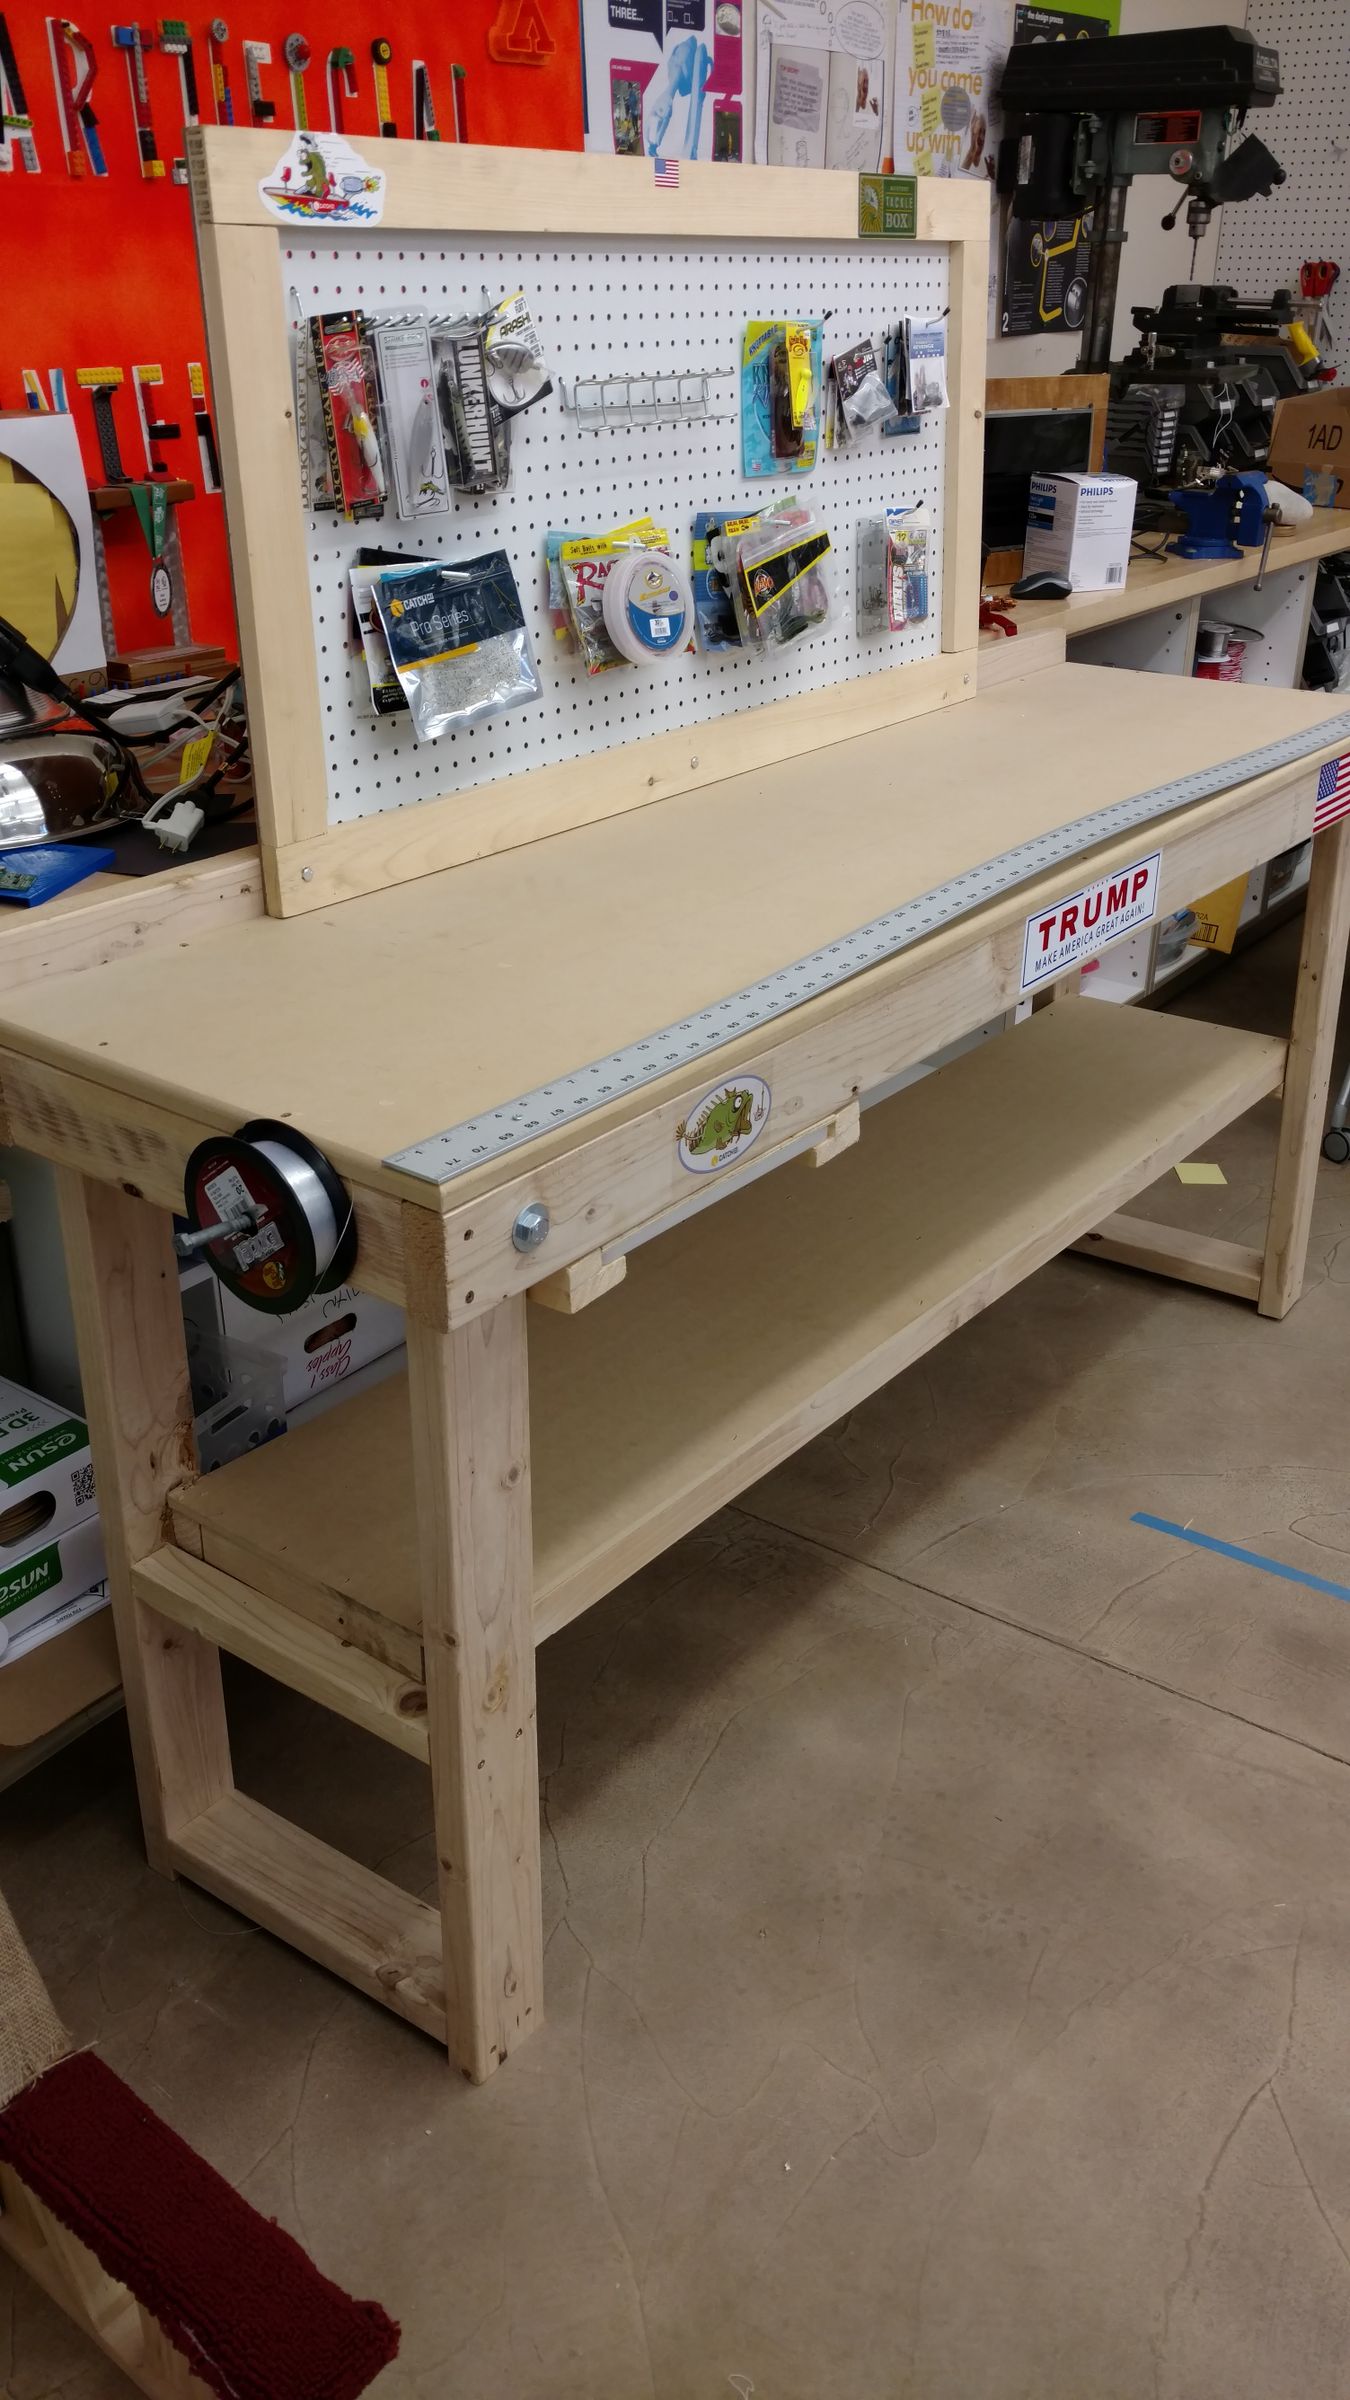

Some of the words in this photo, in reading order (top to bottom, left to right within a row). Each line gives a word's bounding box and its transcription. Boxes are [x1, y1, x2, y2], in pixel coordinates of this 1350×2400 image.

[952, 0, 973, 31] do
[907, 67, 938, 96] you
[940, 70, 983, 95] come
[905, 131, 926, 155] up
[885, 213, 908, 228] BOX
[1002, 312, 1009, 332] 2
[456, 339, 494, 473] LUNKERHUNT
[1307, 423, 1342, 450] 1AD
[299, 444, 311, 509] LUCKY
[1031, 481, 1057, 494] PHILIPS
[1080, 486, 1114, 496] PHILIPS
[409, 620, 432, 637] Pro
[432, 609, 469, 631] Series
[1039, 868, 1149, 952] TRUMP
[1034, 950, 1058, 972] MAKE
[1058, 932, 1094, 960] AMERICA
[1095, 916, 1119, 938] GREAT
[1120, 902, 1145, 924] AGAIN!
[636, 1044, 650, 1052] 10
[658, 1033, 671, 1041] 11
[679, 1023, 693, 1031] 12
[699, 1013, 713, 1021] 13
[444, 1157, 462, 1168] 71
[471, 1144, 489, 1154] 70
[498, 1131, 514, 1142] 69
[523, 1120, 540, 1130] 68
[549, 1108, 565, 1118] 67
[573, 1096, 589, 1106] 66
[597, 1085, 613, 1094] 65
[619, 1074, 636, 1083] 64
[642, 1063, 658, 1072] 63
[663, 1052, 679, 1061] 62
[685, 1042, 700, 1050] 61
[310, 1374, 316, 1389] 1
[320, 1355, 351, 1380] Class
[8, 1411, 40, 1429] 3D
[8, 1432, 77, 1472] eSUN
